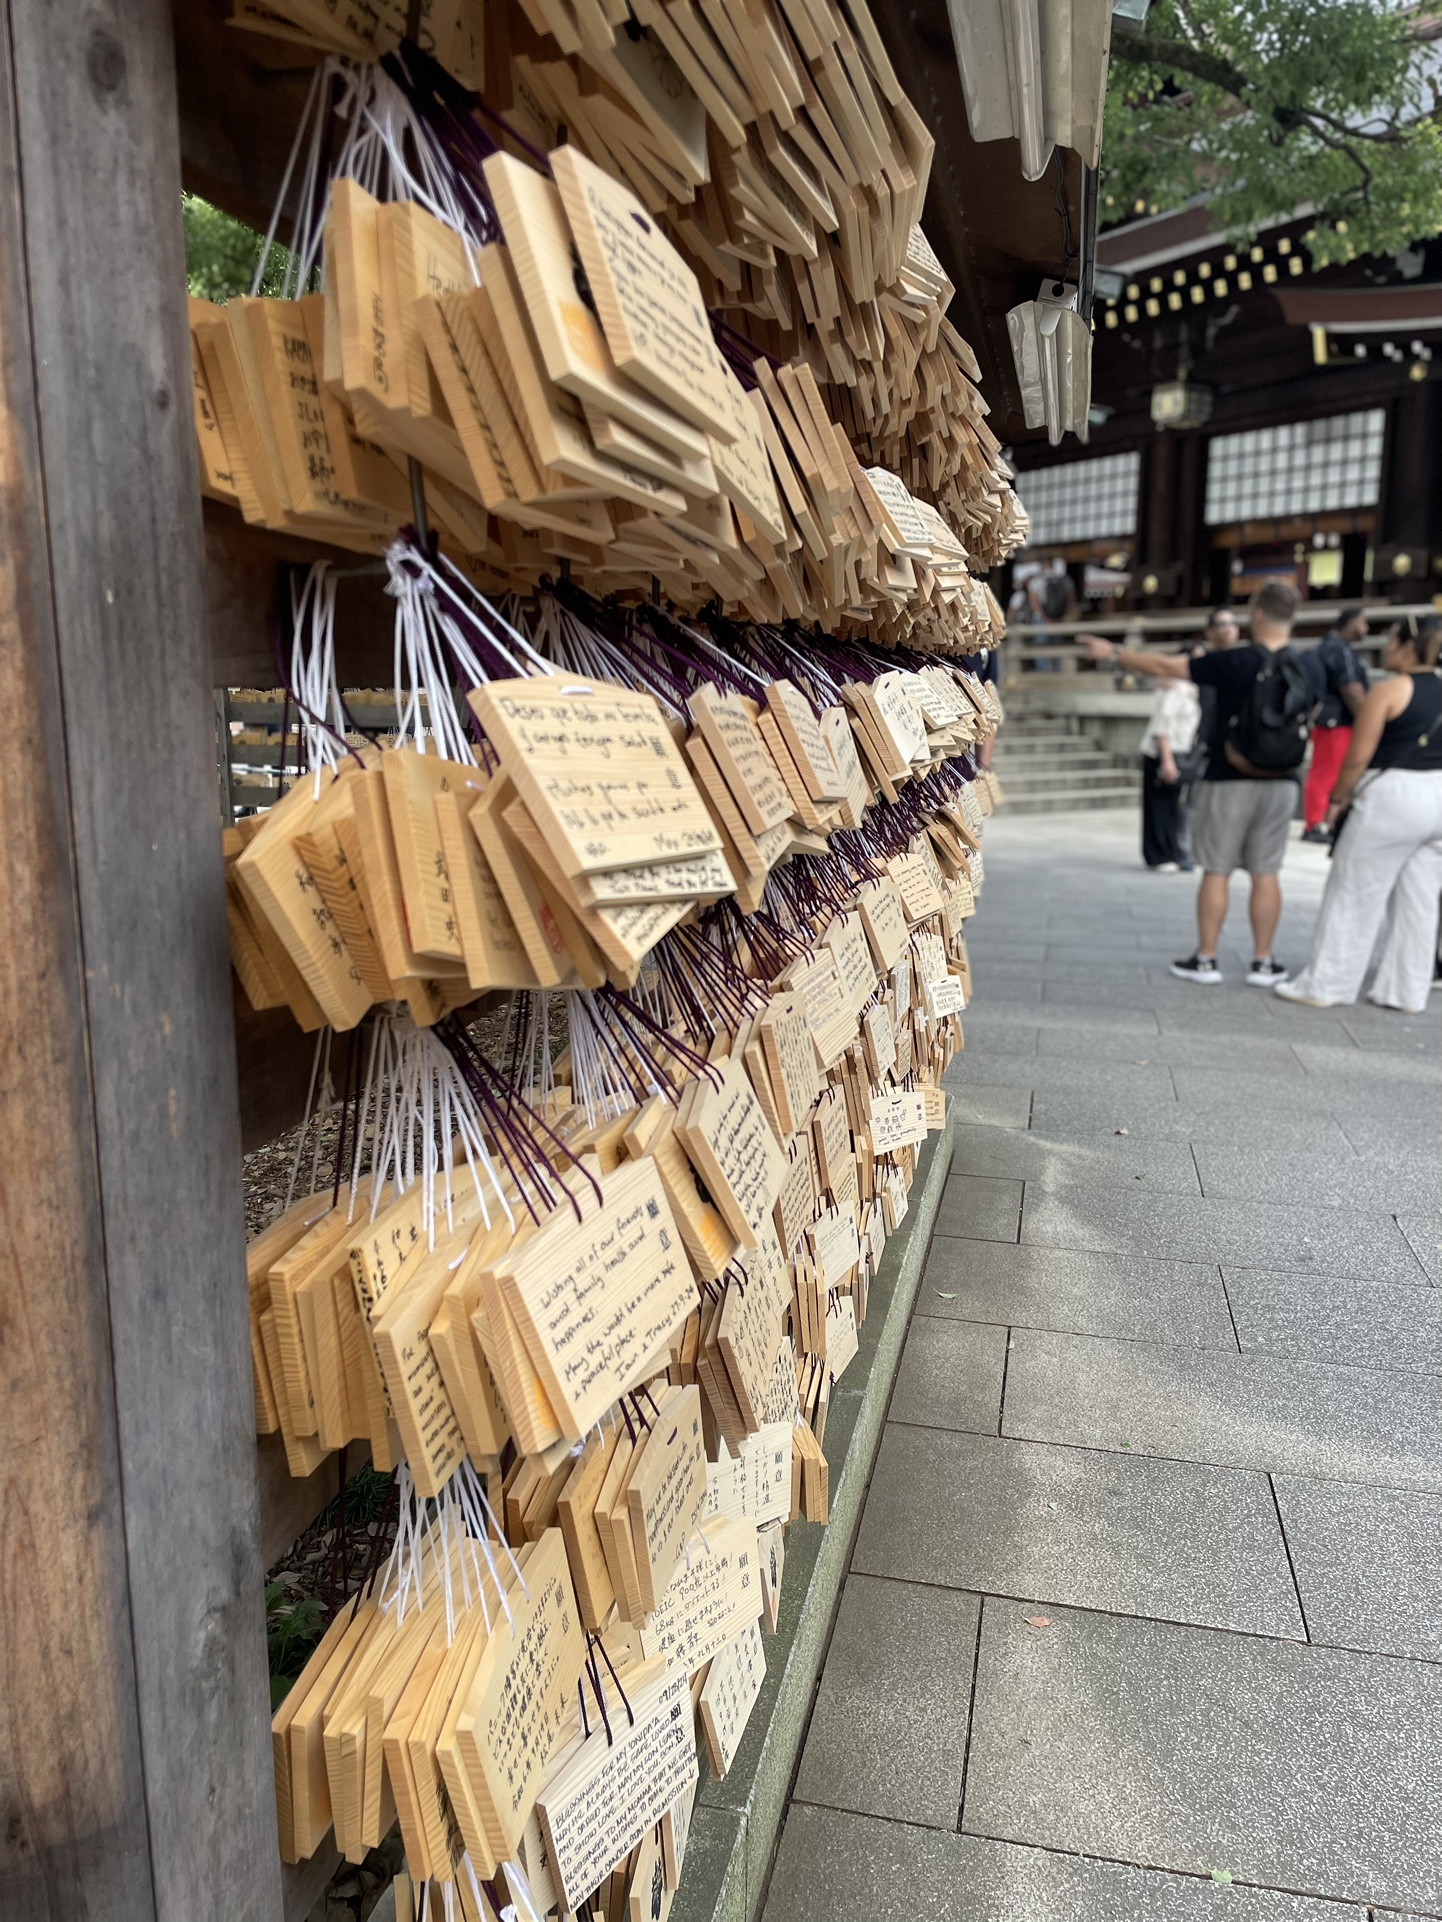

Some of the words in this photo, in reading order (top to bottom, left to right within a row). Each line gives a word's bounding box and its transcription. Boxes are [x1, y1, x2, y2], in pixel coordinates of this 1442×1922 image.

[541, 1274, 577, 1309] Wishing
[575, 1257, 586, 1274] all
[589, 1243, 600, 1262] of
[600, 1232, 614, 1251] our
[616, 1206, 644, 1236] friends
[549, 1301, 571, 1330] and
[572, 1275, 605, 1306] family
[604, 1247, 627, 1272] health
[628, 1225, 646, 1251] and
[564, 1357, 590, 1382] May
[586, 1340, 603, 1354] the
[644, 1276, 661, 1297] more
[614, 1352, 639, 1382] Ian
[645, 1315, 672, 1341] Tracy
[646, 1503, 656, 1528] May
[555, 1776, 601, 1830] BLESSINGS
[601, 1760, 615, 1778] FOR
[616, 1746, 627, 1764] MY
[555, 1823, 571, 1845] MAY
[571, 1809, 585, 1827] HE
[586, 1774, 616, 1811] ALWAYS
[617, 1760, 630, 1778] BE
[558, 1837, 574, 1858] AND
[617, 1772, 632, 1793] MAY
[632, 1761, 644, 1776] MY
[644, 1746, 658, 1765] SON
[659, 1723, 678, 1748] LEARN
[561, 1856, 572, 1868] TO
[574, 1828, 597, 1855] SHOW
[627, 1773, 645, 1796] LOVE
[564, 1837, 604, 1885] BLESSINGS
[606, 1826, 616, 1837] TO
[616, 1811, 627, 1827] MY
[627, 1784, 652, 1815] MOMMA
[651, 1767, 666, 1786] THAT
[567, 1890, 584, 1914] MAY
[652, 1778, 687, 1818] REMISSION
[568, 1882, 580, 1897] ALL
[591, 1845, 609, 1868] YOUR
[611, 1812, 638, 1845] WISHES
[648, 1785, 663, 1804] COME
